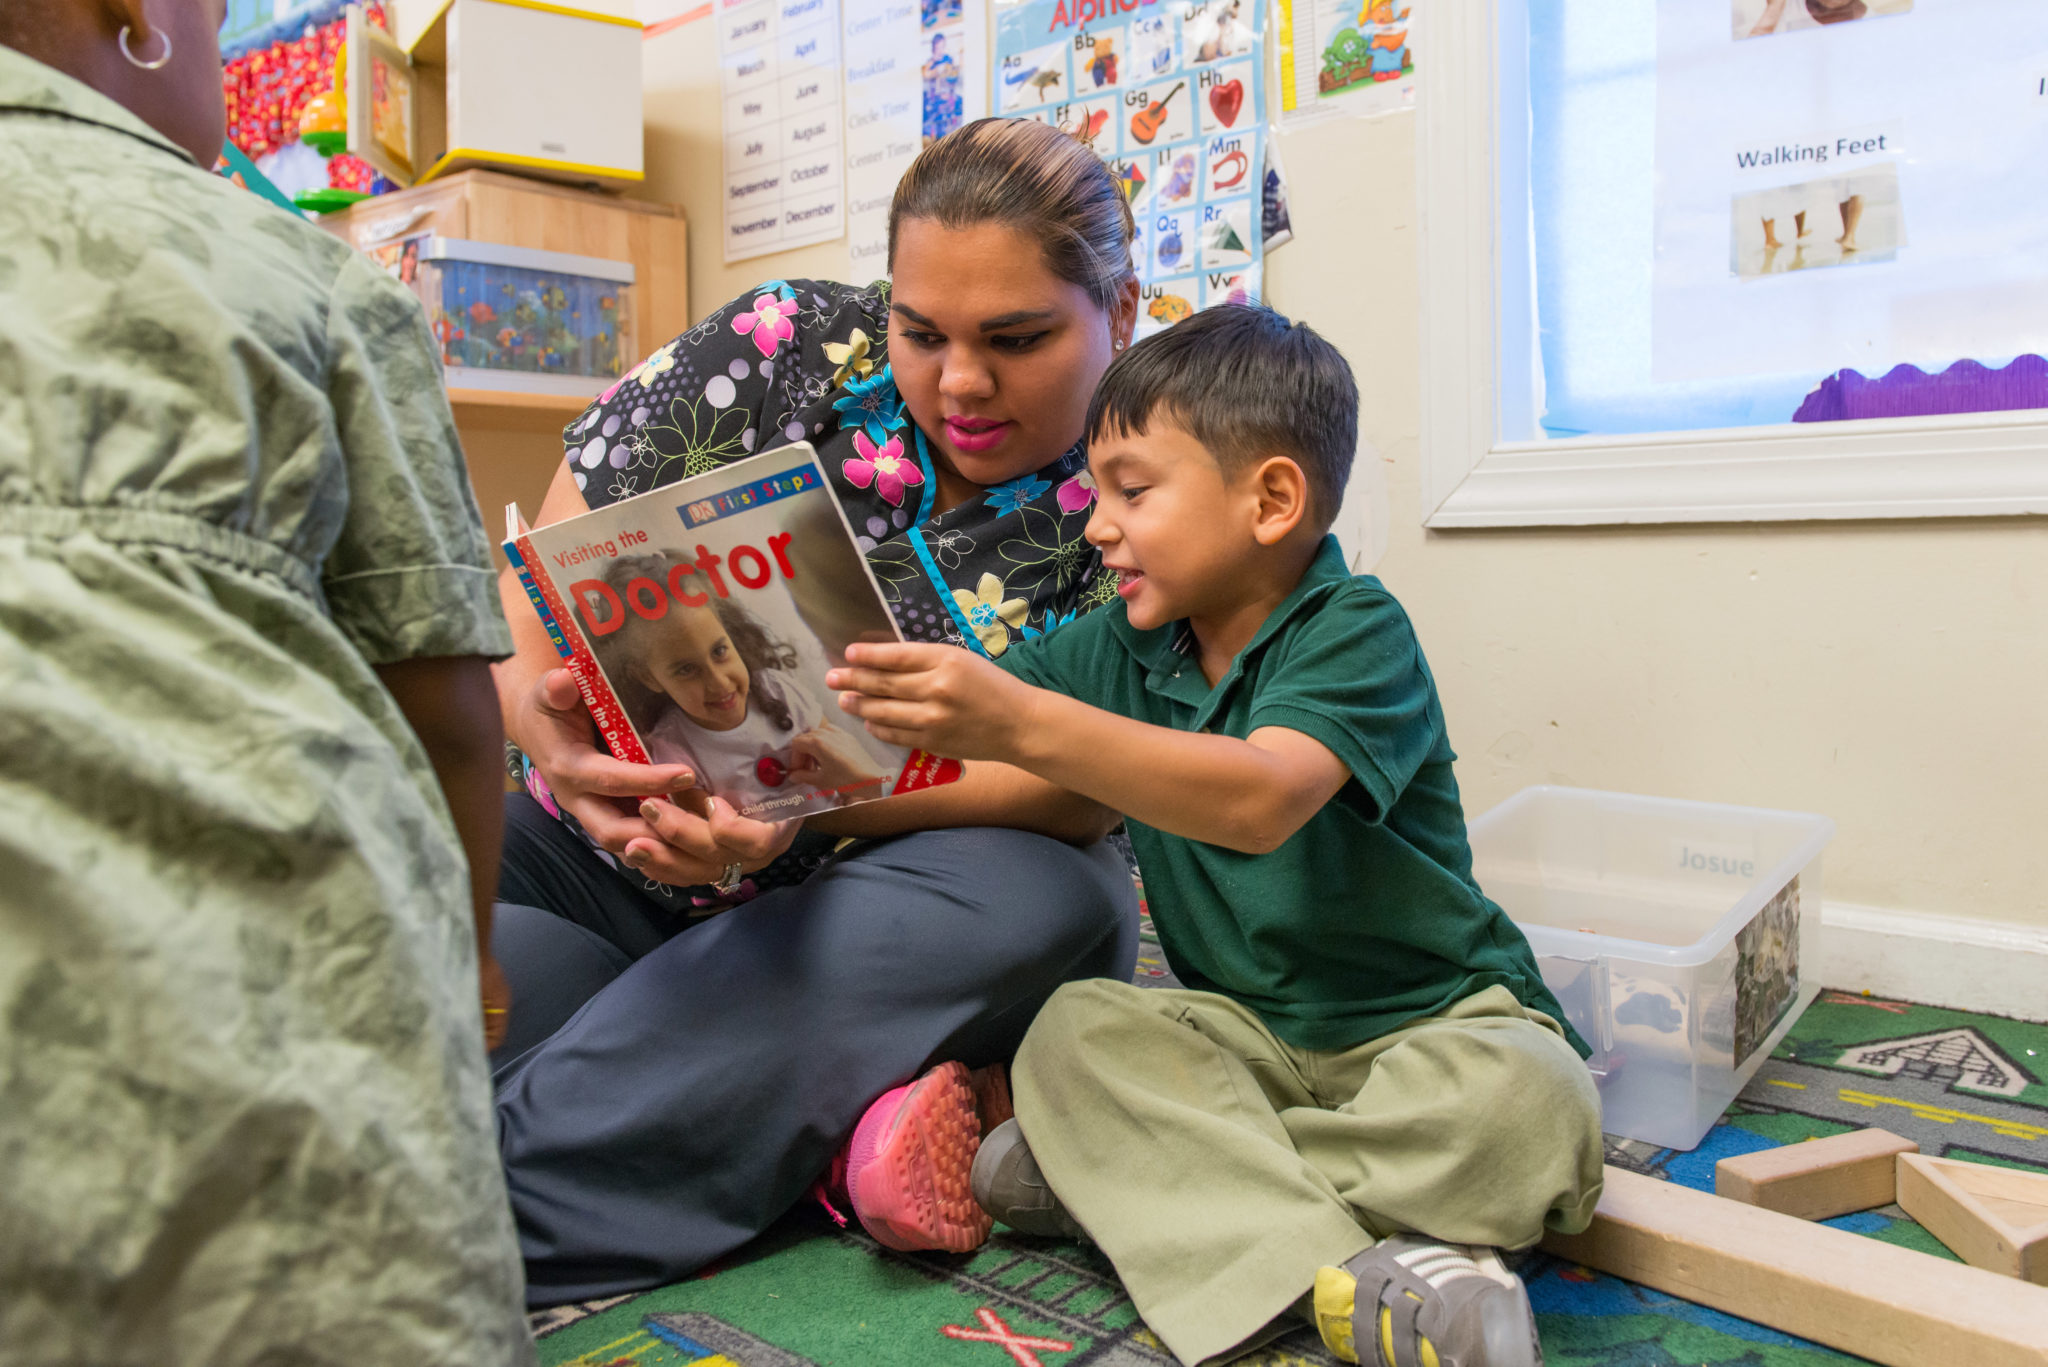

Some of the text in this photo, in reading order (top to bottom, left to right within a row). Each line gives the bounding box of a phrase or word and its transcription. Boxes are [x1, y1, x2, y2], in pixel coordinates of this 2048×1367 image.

[885, 6, 912, 25] Time
[795, 38, 816, 58] April
[1074, 31, 1096, 50] Bb
[1003, 55, 1021, 69] Aa
[1199, 68, 1222, 88] Hh
[796, 84, 818, 100] June
[1125, 90, 1148, 108] Gg
[882, 102, 910, 118] Time
[1056, 103, 1070, 122] Ff
[792, 123, 826, 141] August
[887, 143, 913, 159] Time
[1209, 137, 1241, 156] Mm
[1736, 134, 1887, 169] Walking Feet
[791, 164, 829, 183] October
[730, 178, 779, 199] September
[786, 204, 834, 224] December
[1204, 205, 1222, 223] Rr
[731, 217, 777, 236] November
[1157, 215, 1182, 239] Qq
[1209, 273, 1232, 290] Vv
[1141, 283, 1163, 300] Uu
[687, 472, 814, 524] DK First Steps
[553, 529, 649, 569] Visiting the
[568, 531, 795, 637] Doctor
[523, 577, 544, 611] First
[541, 613, 568, 653] Steps
[566, 656, 598, 706] Visiting
[593, 705, 610, 730] the
[905, 750, 928, 788] with ove
[742, 802, 765, 816] child
[765, 794, 805, 812] through
[1679, 847, 1754, 878] Josue
